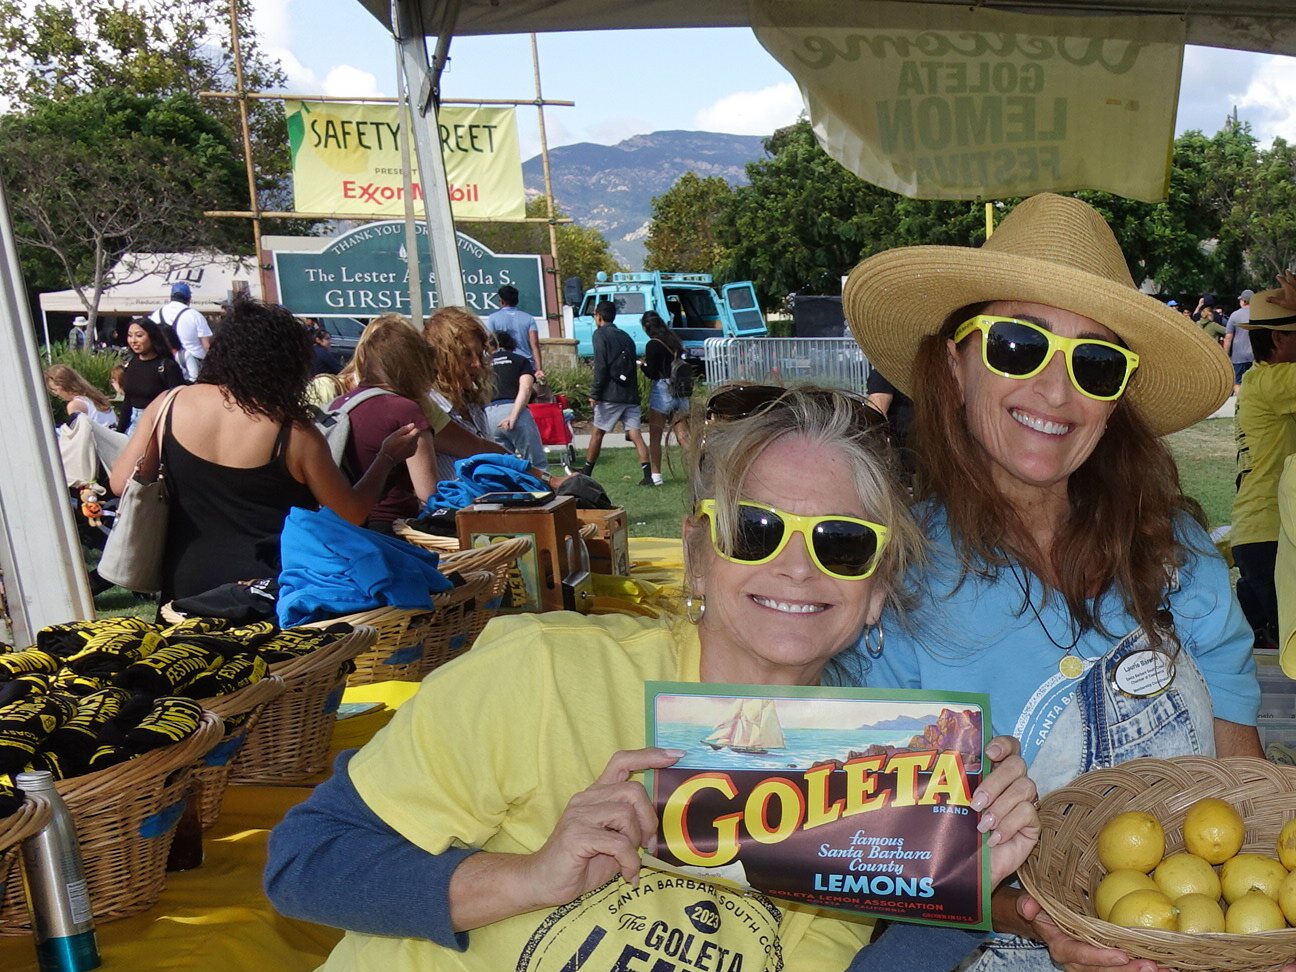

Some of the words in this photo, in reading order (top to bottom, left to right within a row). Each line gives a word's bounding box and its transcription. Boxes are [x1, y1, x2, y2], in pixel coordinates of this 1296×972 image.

[310, 119, 400, 151] SAFETY
[332, 231, 374, 255] THANK
[375, 225, 400, 236] YOU
[305, 268, 335, 282] The
[342, 267, 396, 284] Lester
[462, 269, 493, 285] iola
[499, 270, 516, 285] S.
[325, 289, 410, 309] GIRSH
[428, 292, 501, 309] PRK
[1035, 704, 1062, 746] SANTA
[662, 749, 972, 868] GOLETA
[932, 806, 969, 816] BRAND
[849, 829, 905, 846] famous
[818, 843, 864, 859] Santa
[867, 845, 932, 860] Barbara
[849, 858, 905, 875] County
[814, 873, 935, 898] LEMONS
[607, 884, 654, 915] SANTA
[719, 895, 760, 933] SOUTH
[768, 889, 815, 899] GOLETA
[819, 894, 860, 904] LEMON
[864, 898, 944, 911] ASSOCIATION
[617, 912, 647, 933] The
[694, 905, 720, 928] 2023
